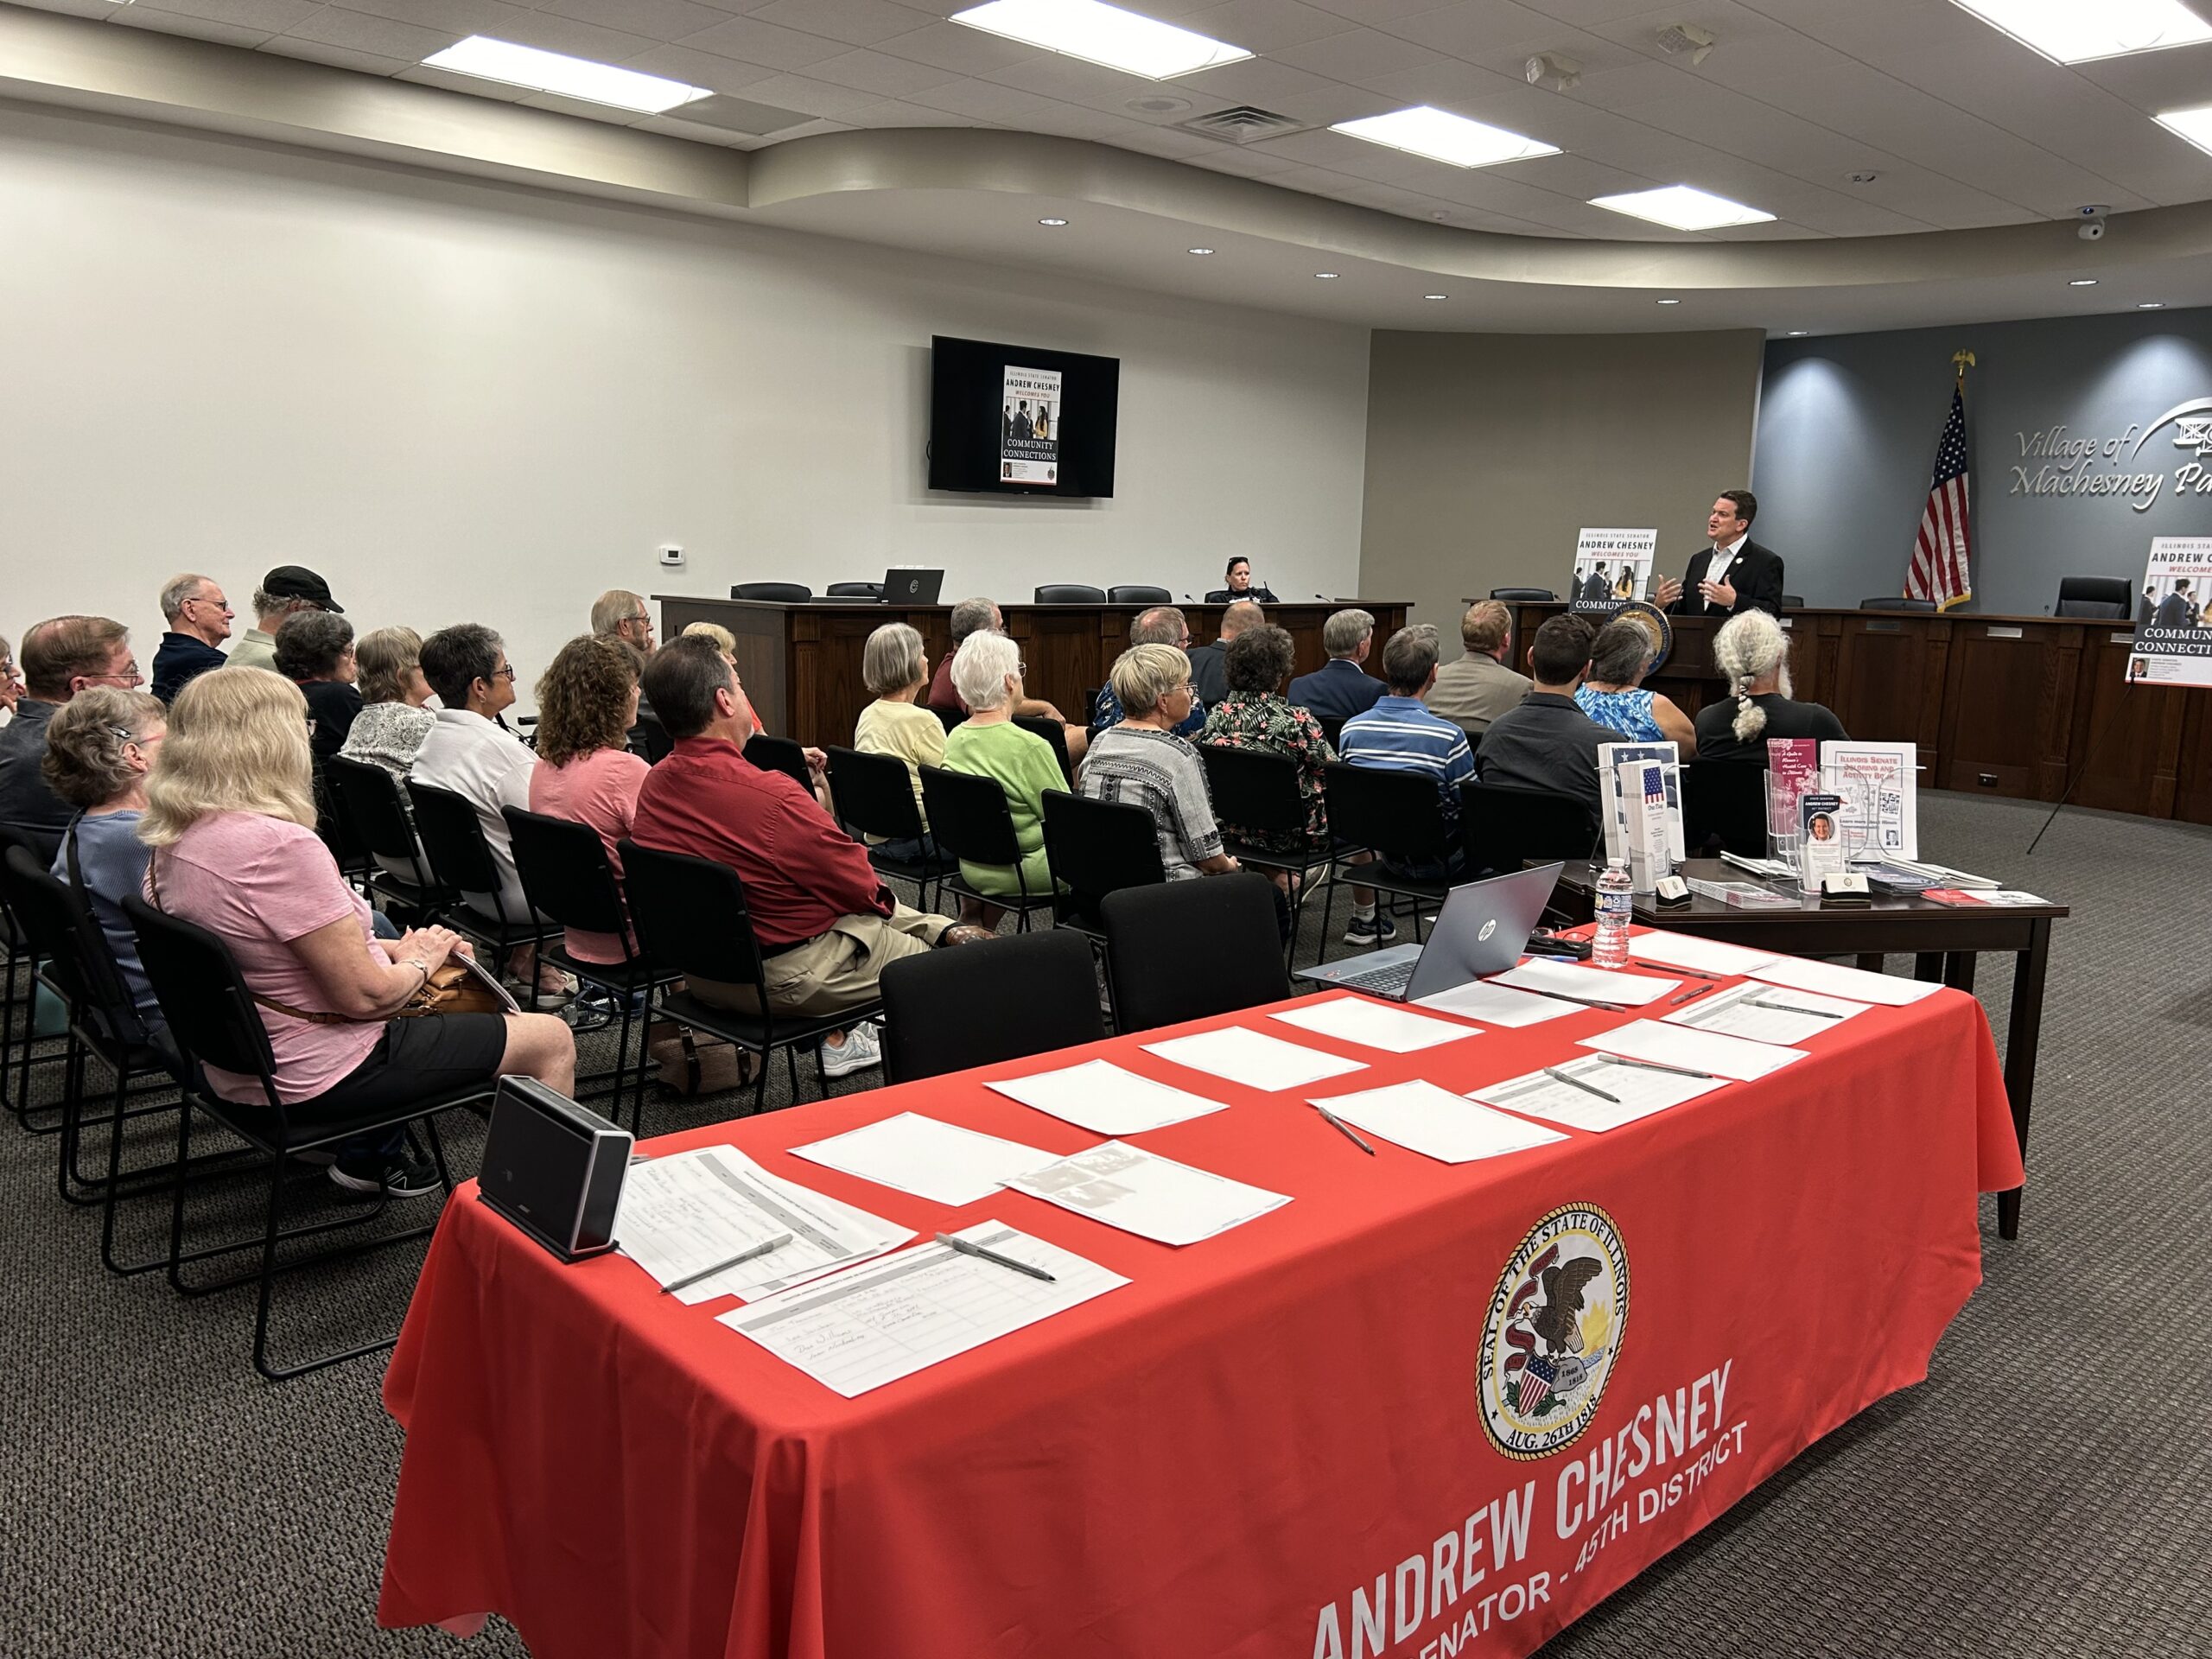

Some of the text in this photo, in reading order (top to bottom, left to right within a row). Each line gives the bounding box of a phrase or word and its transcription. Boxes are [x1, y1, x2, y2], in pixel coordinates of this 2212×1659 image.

[1006, 378, 1060, 391] ANDREW CHESNEY
[1007, 438, 1053, 449] COMMUNITY
[2014, 423, 2139, 471] Village of
[1003, 448, 1057, 461] CONNECTIONS
[2009, 459, 2164, 511] Machesney
[1617, 541, 1654, 550] CHESNEY
[2152, 553, 2203, 563] ANDREW
[1575, 601, 1625, 610] COMMUN
[2135, 641, 2212, 654] CONNECTI
[1530, 1249, 1556, 1274] UNION
[1483, 1213, 1624, 1381] SEAL OF THE STATE OF ILLINOIS
[1506, 1394, 1597, 1449] AUG. 26TH 1818
[1312, 1358, 1733, 1659] ANDREW CHESNEY
[1409, 1571, 1551, 1659] ENATOR
[1574, 1510, 1628, 1573] 45TH
[1638, 1421, 1748, 1526] DISTRICT
